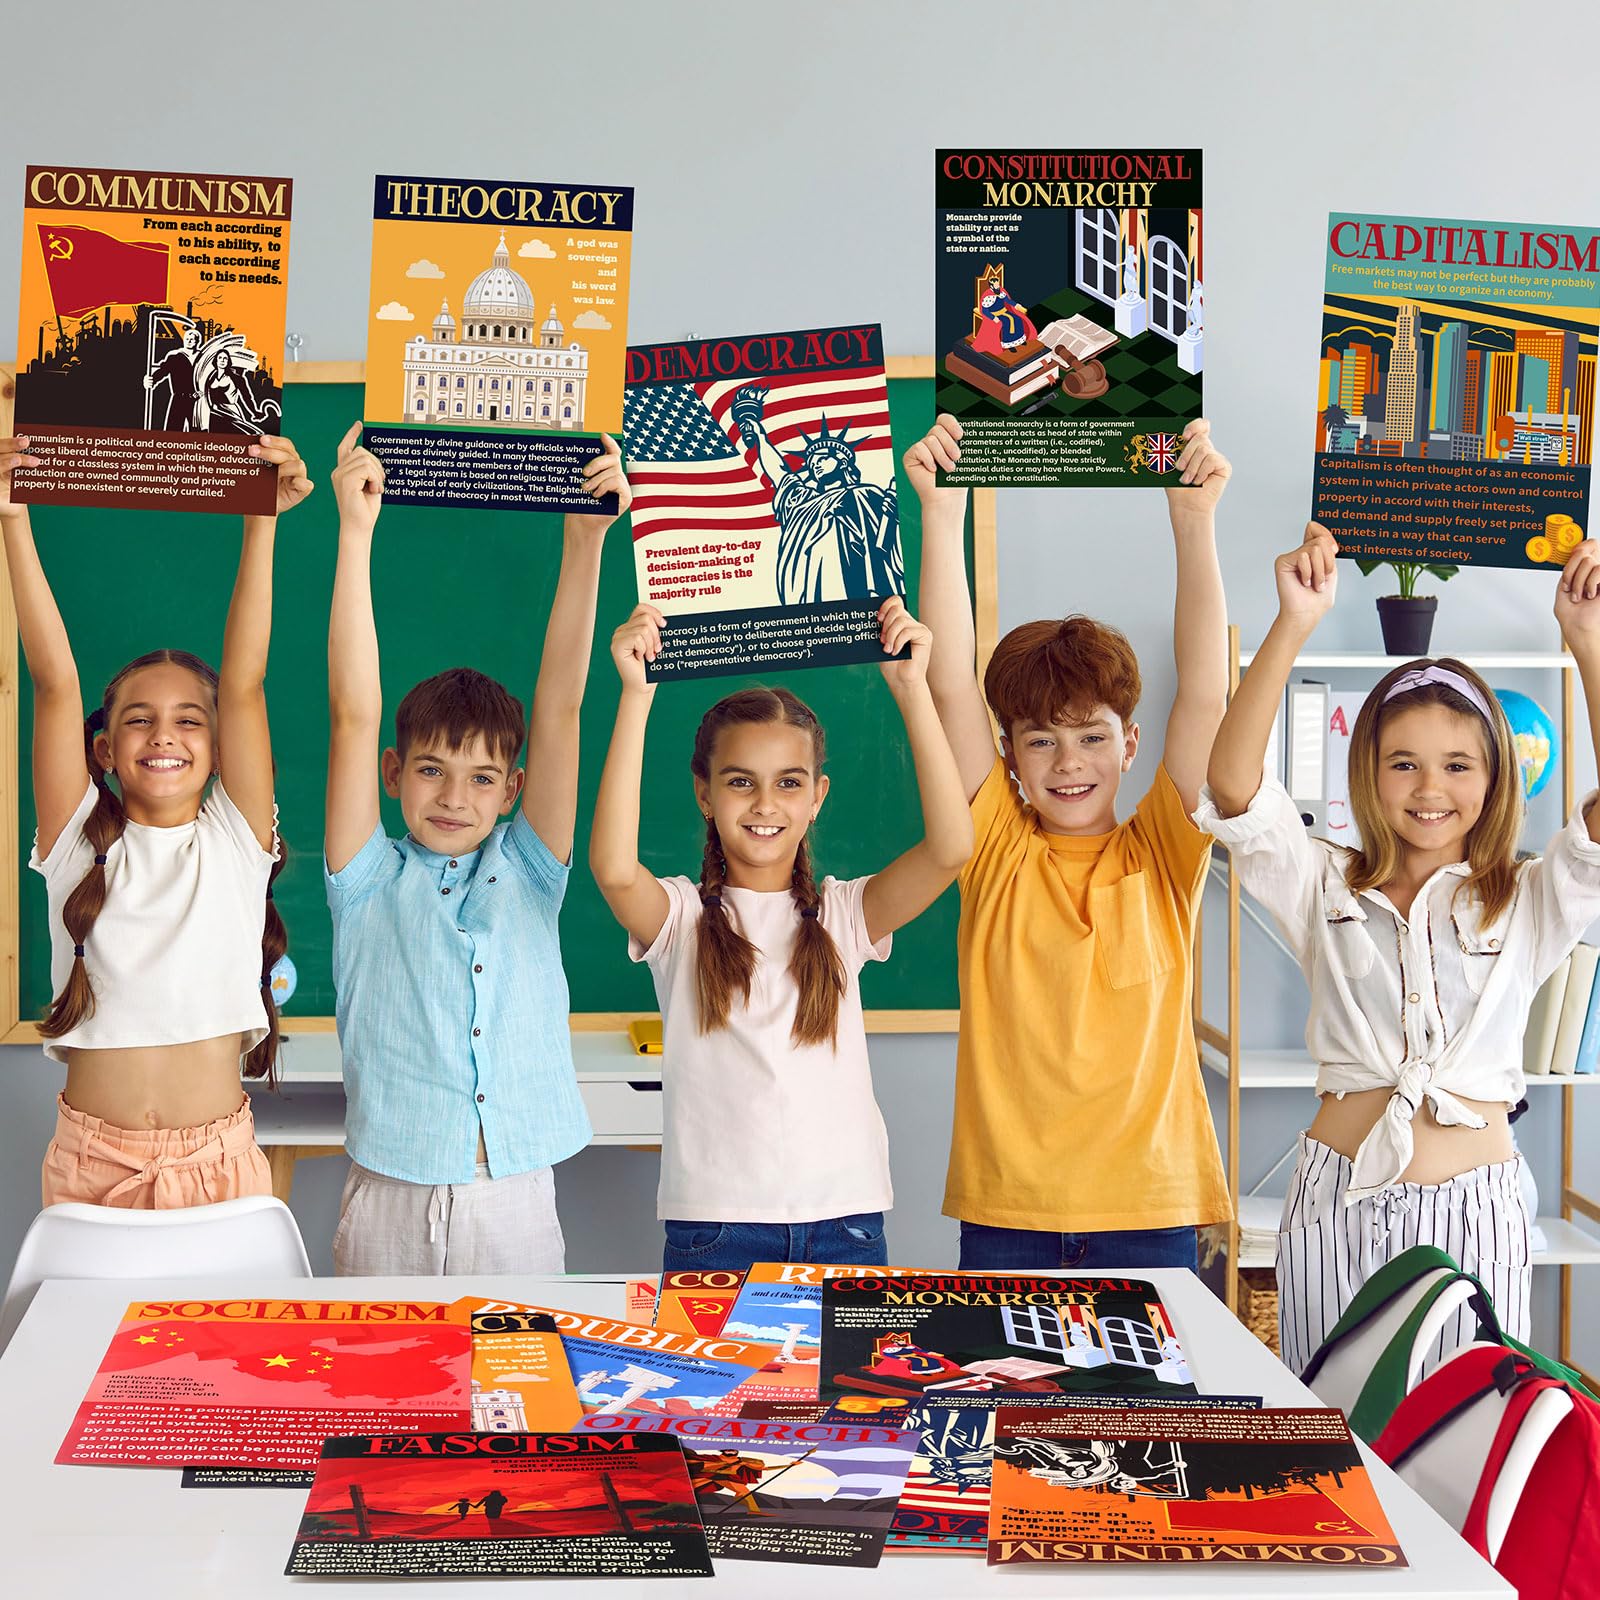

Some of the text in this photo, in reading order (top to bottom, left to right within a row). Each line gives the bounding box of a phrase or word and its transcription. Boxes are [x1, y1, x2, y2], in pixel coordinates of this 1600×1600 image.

[943, 154, 1192, 180] CONSTITUTIONAL
[30, 171, 287, 216] COMMUNISM
[982, 182, 1158, 207] MONARCHY
[387, 181, 624, 225] THEOCRACY
[946, 213, 1022, 223] Monarchs provide
[143, 218, 282, 238] From each according
[946, 223, 982, 233] stability
[178, 236, 281, 253] to his ability, to
[566, 238, 574, 247] A
[576, 239, 596, 249] god
[953, 234, 984, 244] symbol
[985, 234, 995, 242] of
[1329, 221, 1600, 273] CAPITALISM
[979, 244, 1010, 253] nation.
[178, 253, 281, 271] each according
[568, 254, 618, 264] sovereign
[200, 270, 282, 285] to his needs.
[597, 268, 617, 277] and
[1332, 264, 1595, 290] Free markets may not be perfect but they are probably
[572, 280, 616, 291] his word
[1373, 279, 1554, 301] the best way to organize an economy.
[595, 296, 616, 305] law.
[625, 327, 877, 384] DEMOCRACY
[370, 435, 423, 445] Government
[424, 437, 436, 448] by
[436, 438, 464, 448] divine
[464, 440, 504, 450] guidance
[517, 442, 528, 452] by
[529, 443, 564, 452] officials
[565, 445, 585, 453] who
[586, 447, 603, 457] are
[960, 437, 1004, 447] parameters
[1050, 438, 1068, 447] (i.e.,
[1069, 438, 1106, 447] codified),
[14, 468, 66, 478] production
[86, 472, 119, 481] owned
[120, 474, 180, 486] communally
[181, 476, 200, 485] and
[201, 476, 236, 487] private
[946, 474, 986, 484] depending
[1320, 458, 1380, 470] Capitalism
[1383, 462, 1392, 471] is
[1395, 462, 1424, 473] often
[1428, 464, 1472, 477] thought
[1475, 467, 1488, 477] of
[1520, 472, 1575, 482] economic
[14, 480, 56, 491] property
[57, 480, 66, 490] is
[67, 482, 124, 492] nonexistent
[137, 486, 179, 497] severely
[180, 487, 226, 497] curtailed.
[402, 488, 416, 496] the
[435, 489, 446, 498] of
[447, 490, 490, 500] theocracy
[491, 492, 499, 500] in
[523, 494, 558, 503] Western
[560, 496, 602, 505] countries.
[645, 540, 762, 559] Prevalent day-to-day
[646, 553, 754, 573] decision-making of
[648, 568, 753, 586] democracies is the
[649, 585, 722, 601] majority rule
[700, 610, 866, 633] is form of government in which the
[650, 662, 662, 671] do
[676, 654, 751, 671] ("representative
[752, 648, 814, 662] democracy").
[1329, 705, 1349, 737] A
[831, 1278, 1143, 1292] CONSTITUTIONAL
[881, 1291, 1101, 1306] MONARCHY
[138, 1301, 451, 1323] SOCIALISM
[582, 1415, 920, 1444] OLIGARCHY
[362, 1433, 641, 1455] FASCISM
[72, 1452, 151, 1460] collective,
[790, 1528, 856, 1538] structure
[995, 1540, 1398, 1565] COMMUNISM
